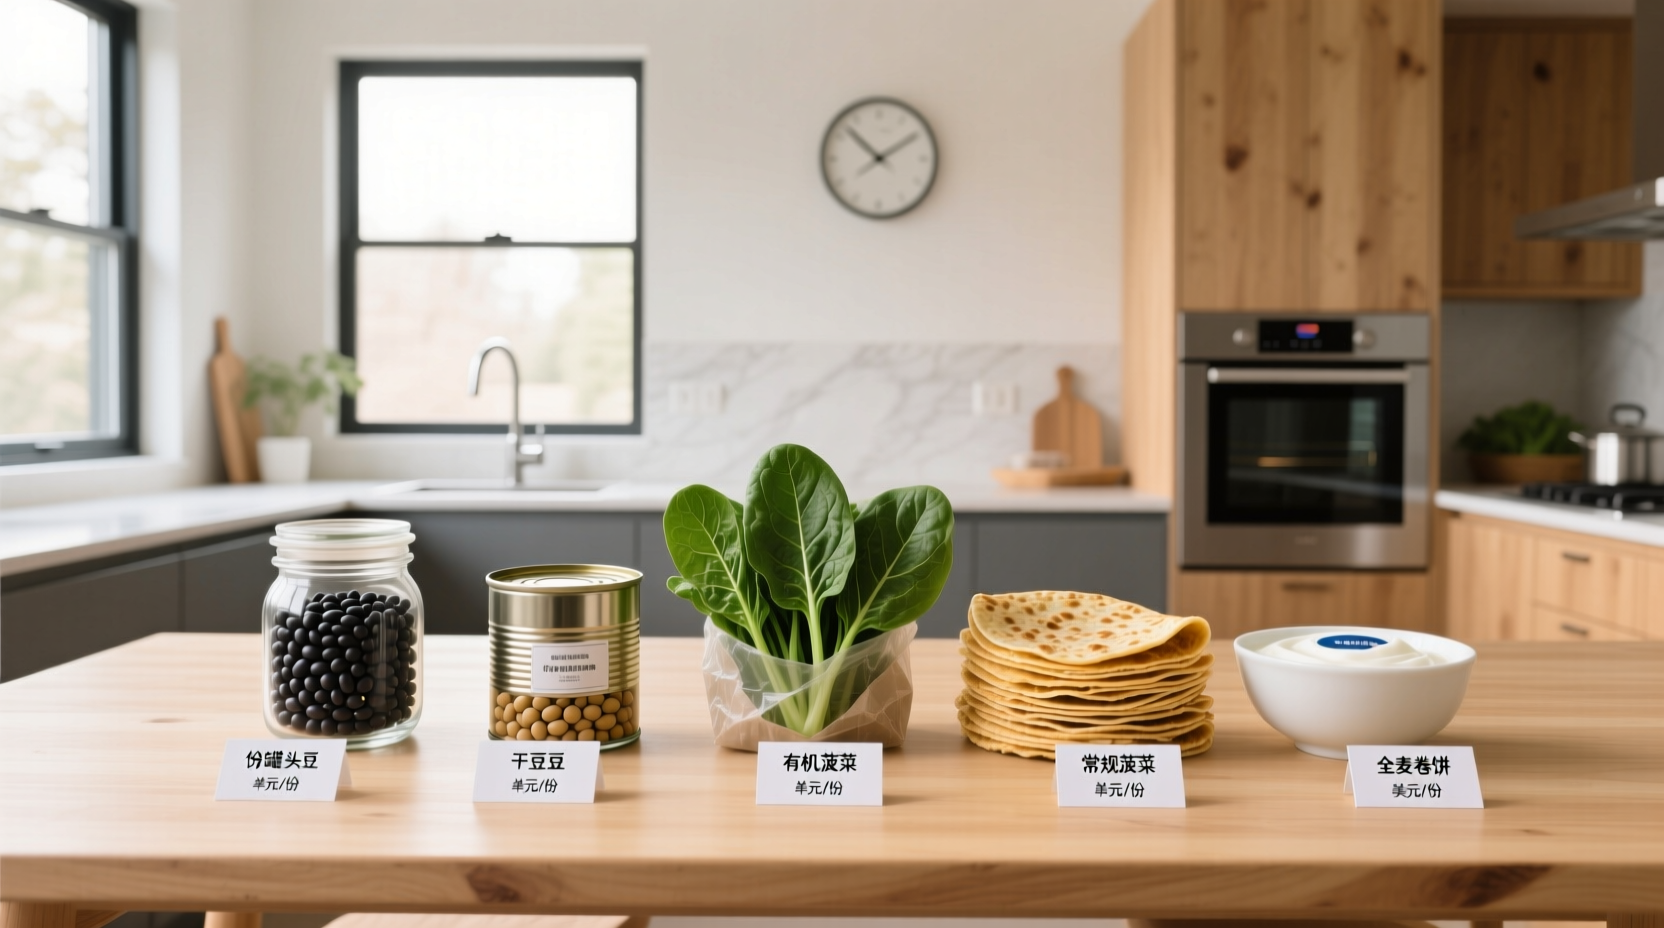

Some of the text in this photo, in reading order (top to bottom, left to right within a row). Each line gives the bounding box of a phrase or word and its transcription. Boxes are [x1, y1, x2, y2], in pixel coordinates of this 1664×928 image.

[511, 752, 565, 770] 干豆豆
[783, 752, 857, 772] 有机菠菜
[1081, 753, 1156, 774] 常规菠菜
[1377, 755, 1451, 776] 全麦卷饼
